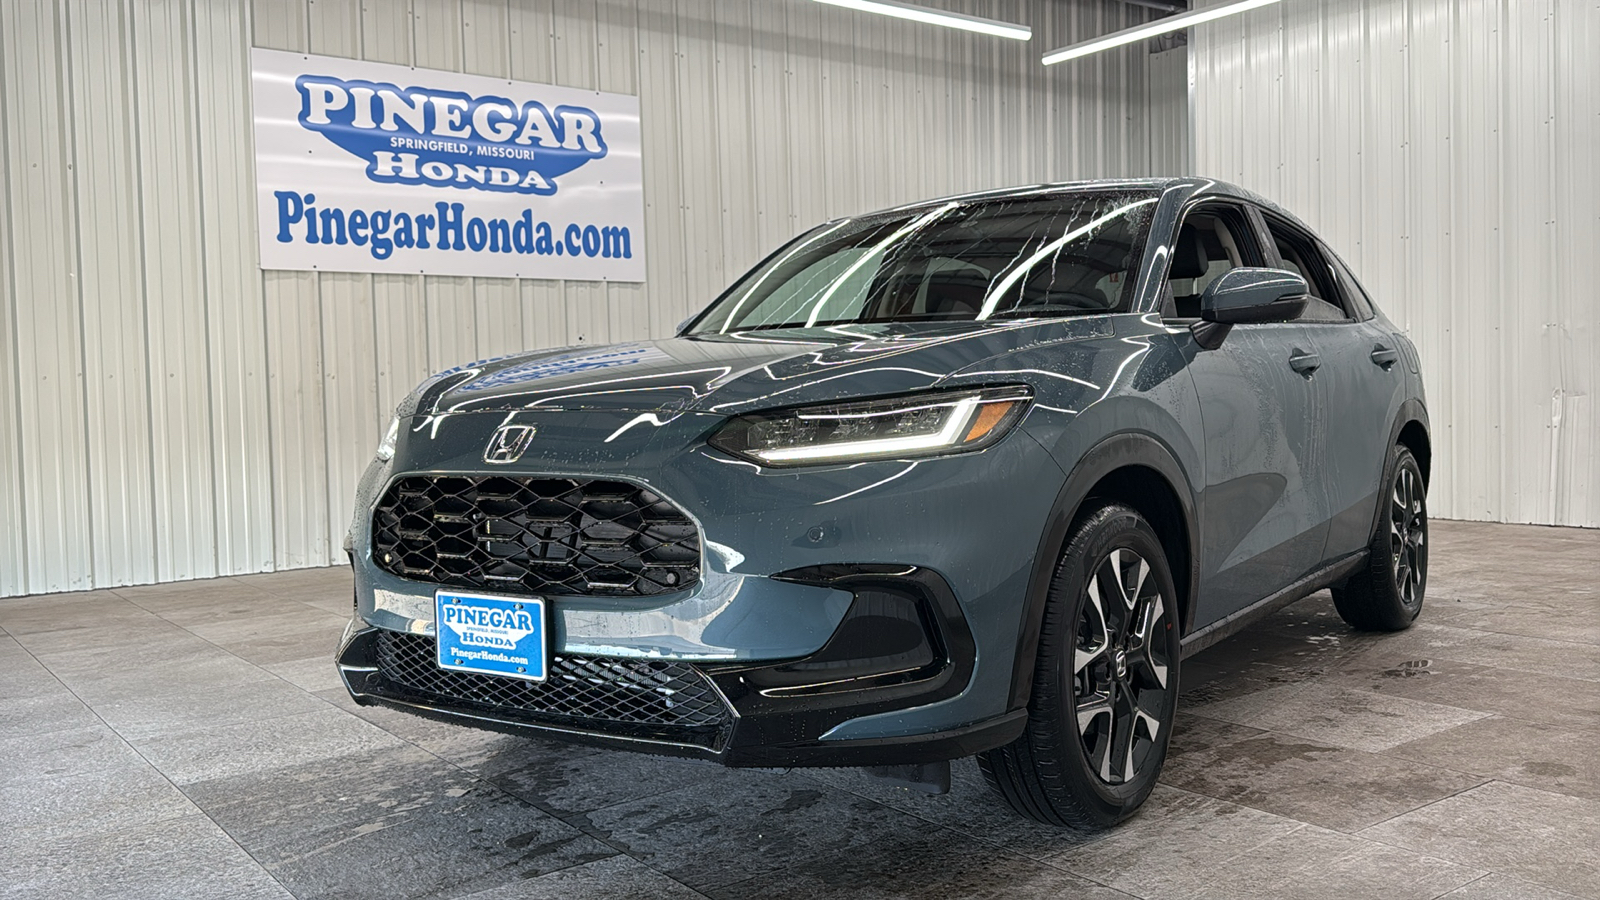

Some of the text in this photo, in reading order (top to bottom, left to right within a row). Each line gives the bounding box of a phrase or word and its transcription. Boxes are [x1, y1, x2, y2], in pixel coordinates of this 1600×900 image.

[303, 82, 603, 153] PINEGAR
[390, 136, 535, 160] SPRINGFIELD, MISSOURI
[373, 151, 551, 189] HONDA
[274, 190, 632, 260] PinegarHonda.com
[445, 607, 531, 631] PINEGAR
[462, 632, 514, 647] HONDA
[451, 647, 528, 665] PinegarHonda.com
